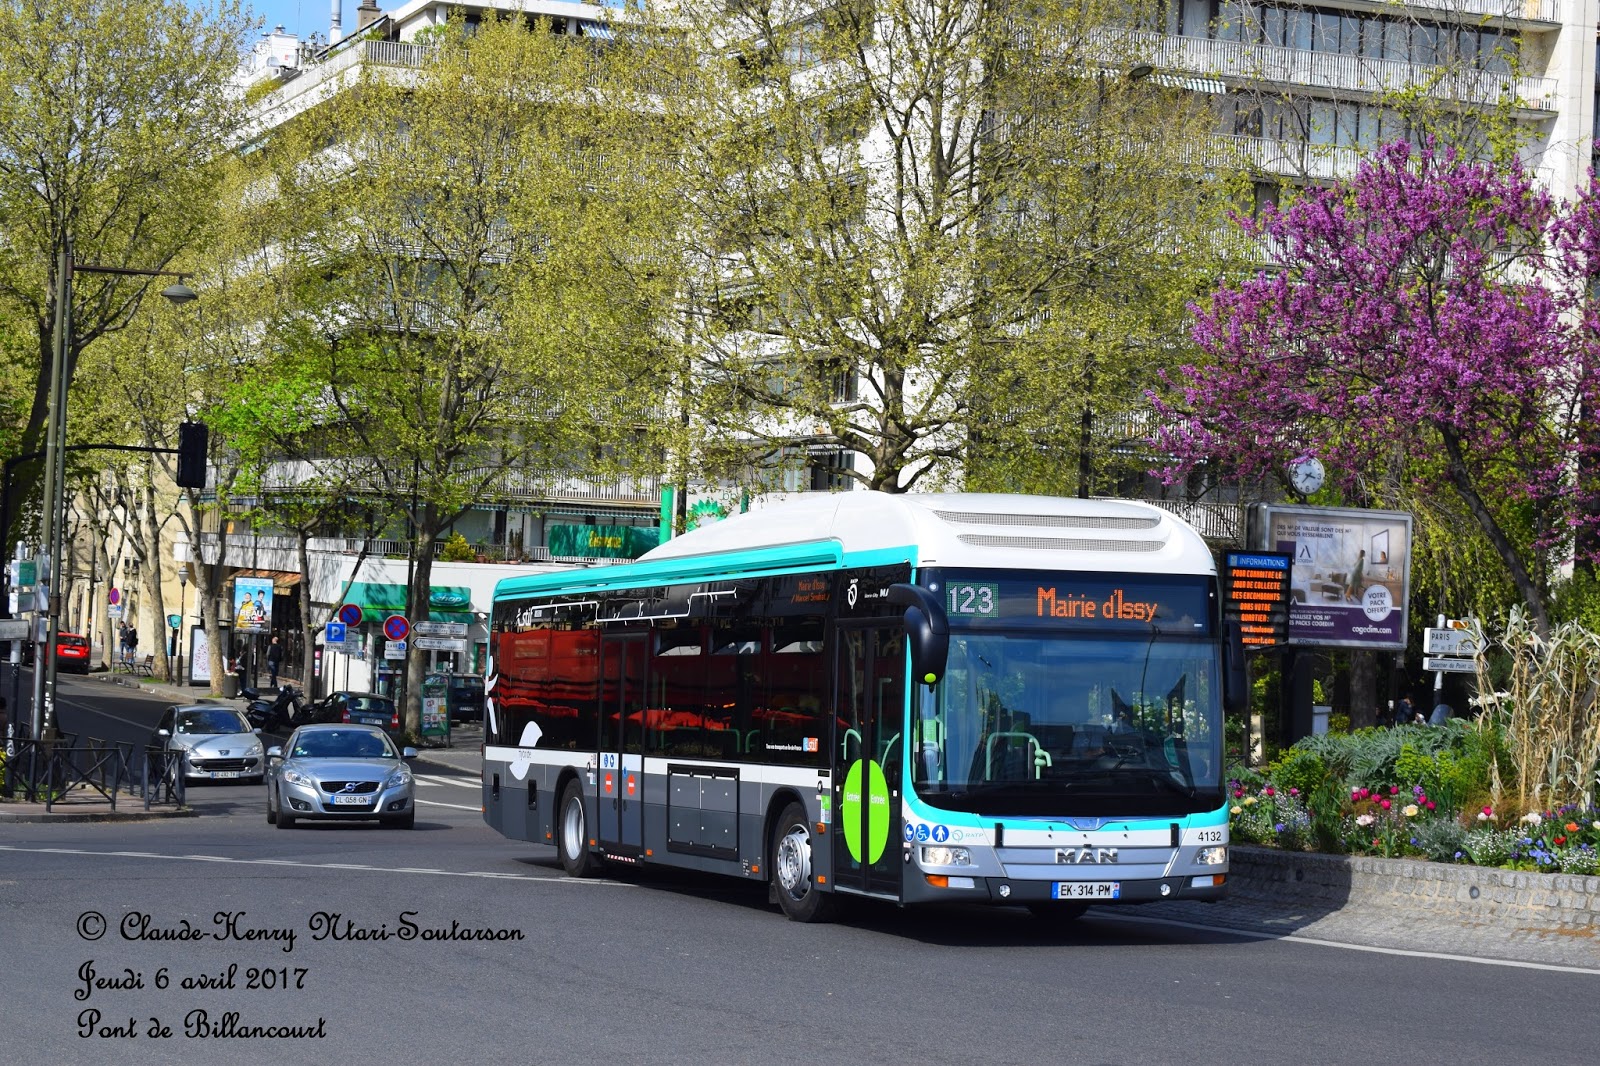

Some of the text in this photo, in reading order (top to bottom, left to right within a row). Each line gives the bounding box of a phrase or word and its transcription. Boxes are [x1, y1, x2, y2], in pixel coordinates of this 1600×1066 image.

[1240, 558, 1285, 567] INFORMATIONS
[1254, 582, 1281, 590] COLLECTE
[949, 585, 994, 614] 123
[1037, 586, 1158, 622] Mairie d'Issy
[331, 626, 340, 639] P
[1352, 624, 1392, 635] cogedim.com
[847, 792, 860, 802] Entrée
[870, 794, 885, 805] Entrée
[1198, 832, 1221, 841] 4132
[1055, 848, 1118, 864] MAN
